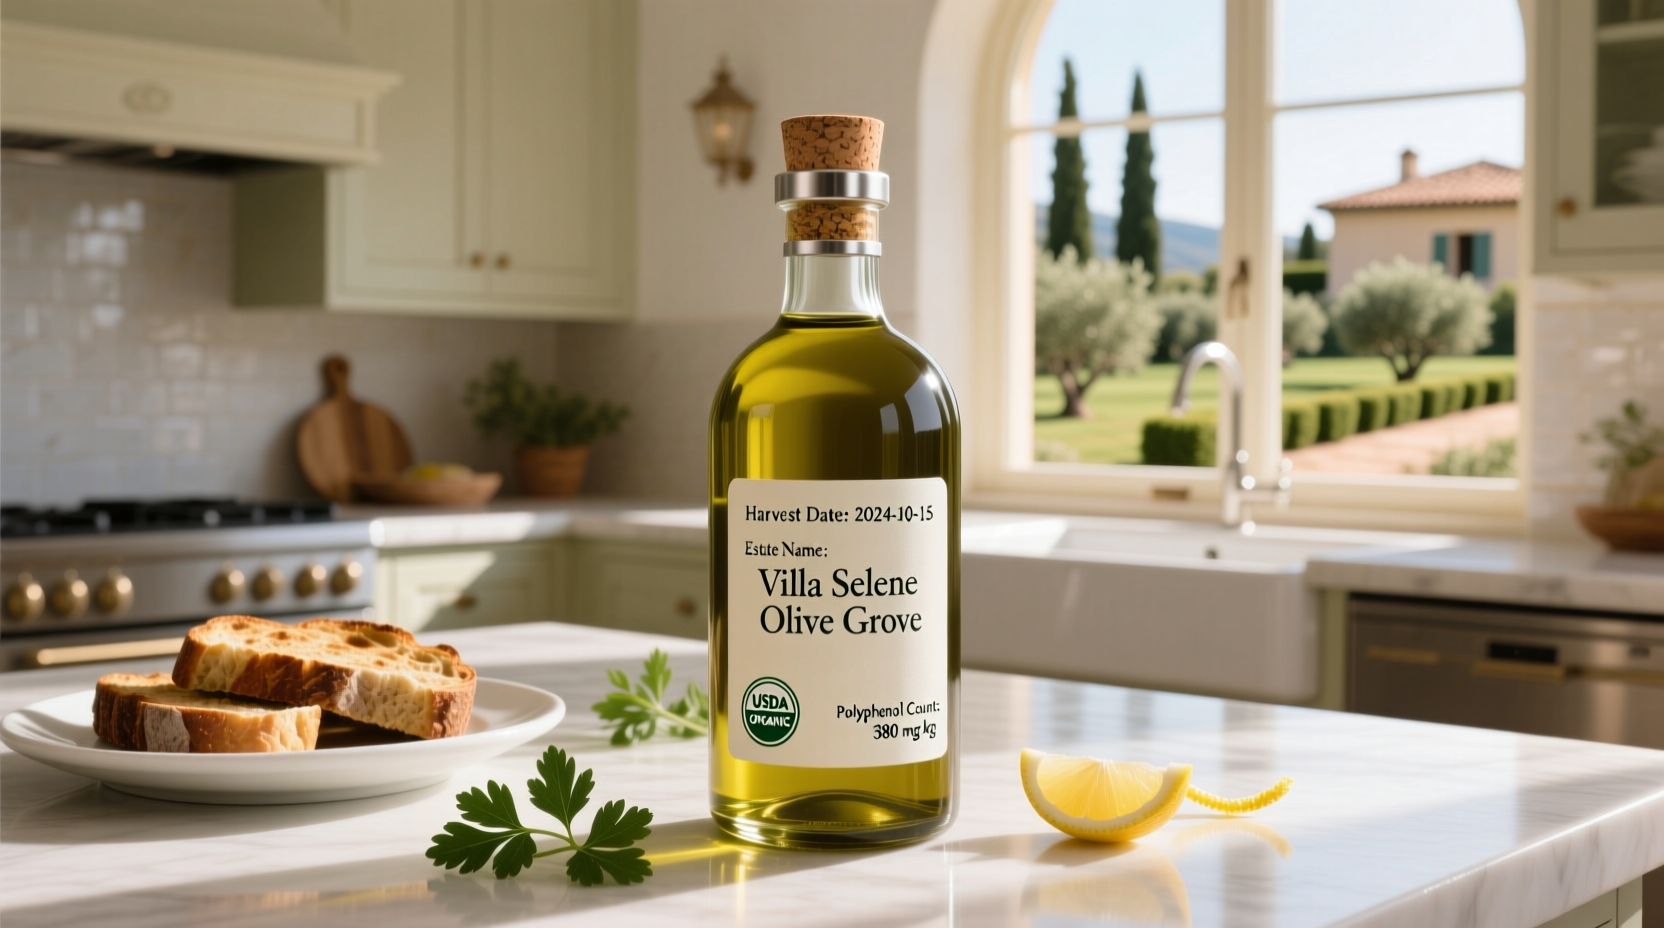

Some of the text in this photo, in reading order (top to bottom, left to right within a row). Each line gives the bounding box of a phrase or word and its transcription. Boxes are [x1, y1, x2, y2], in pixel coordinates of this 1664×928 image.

[745, 505, 934, 523] Harvest Date: 2024-10-15
[781, 541, 828, 558] Name:
[758, 567, 918, 597] Villa Selene
[760, 605, 922, 635] Olive Grove
[752, 693, 789, 711] USDA
[837, 701, 904, 723] Polyphenol
[873, 723, 899, 740] 380
[902, 725, 921, 742] mg
